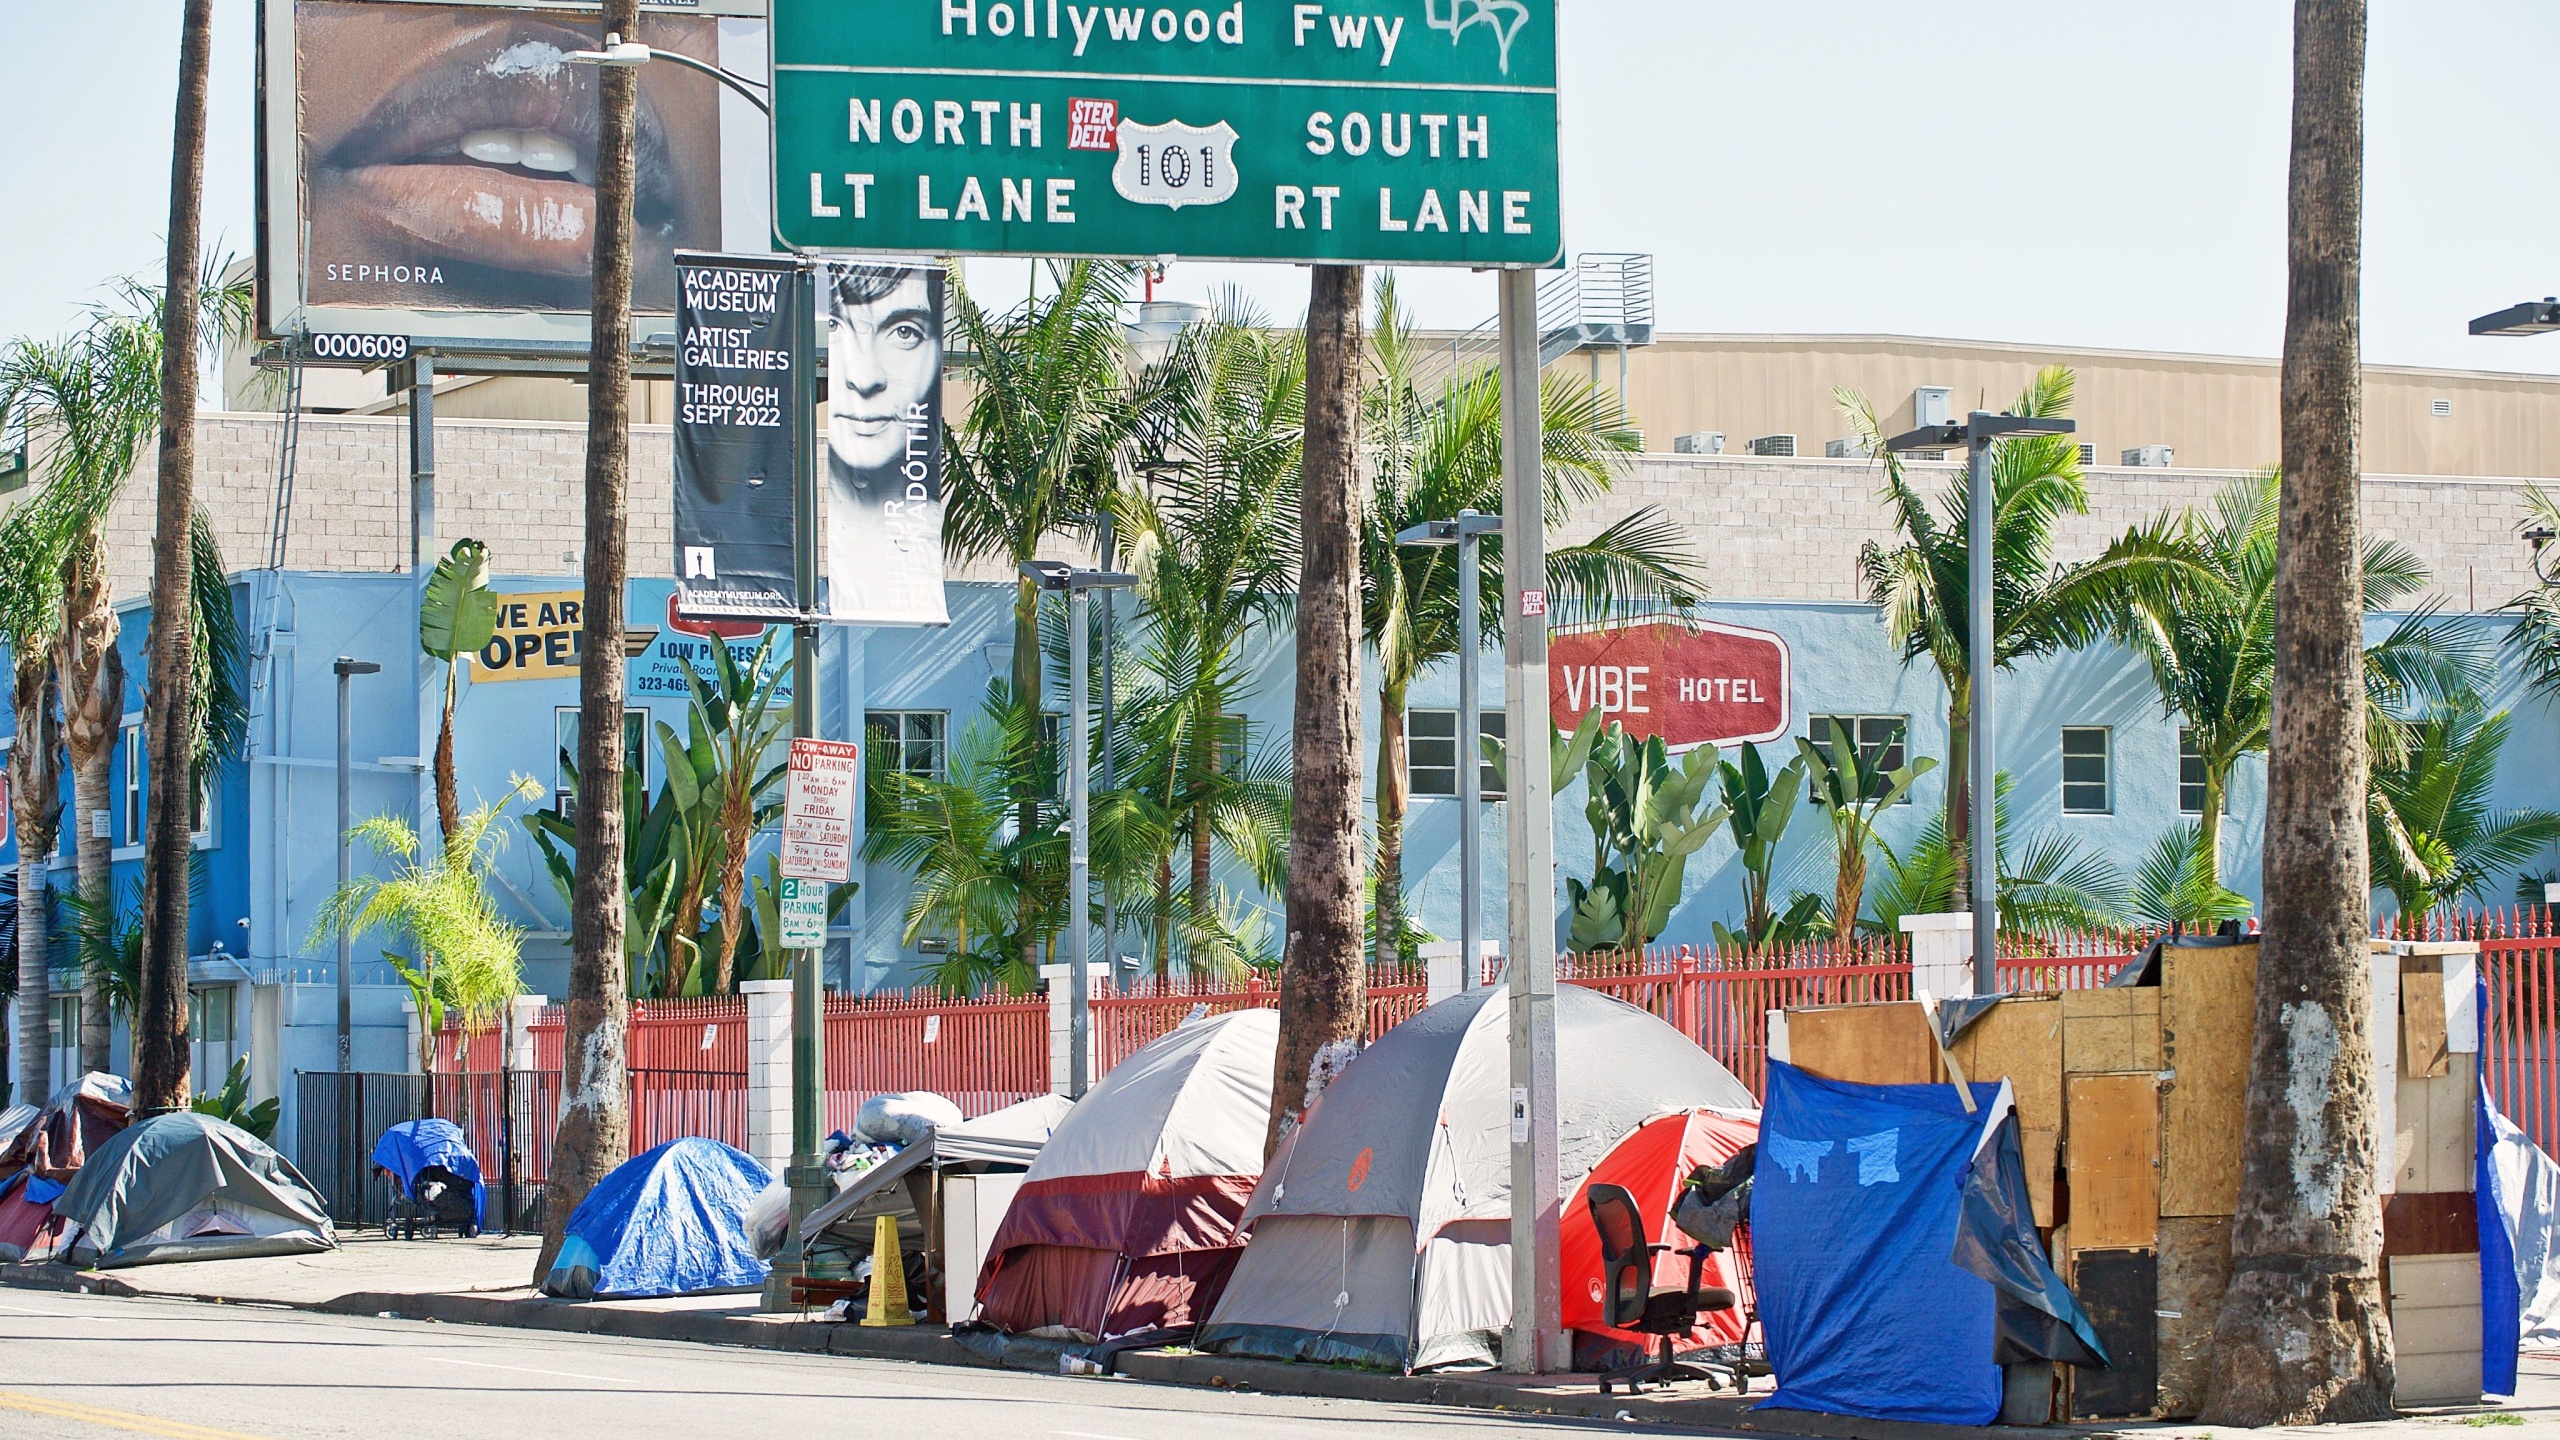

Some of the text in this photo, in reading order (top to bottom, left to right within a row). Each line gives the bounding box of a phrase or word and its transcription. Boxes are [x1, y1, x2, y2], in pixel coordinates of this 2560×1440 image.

[941, 0, 1244, 57] Hollywood
[1294, 4, 1404, 67] Fwy
[849, 98, 1041, 148] NORTH
[1071, 99, 1115, 132] STER
[1306, 111, 1488, 159] SOUTH
[1137, 144, 1214, 188] 101
[810, 172, 1076, 223] LT LANE
[1275, 185, 1531, 234] RT LANE
[327, 263, 444, 284] SEPHORA
[685, 269, 781, 294] ACADEMY
[686, 289, 776, 314] MUSEUM
[314, 334, 407, 359] 000609
[684, 326, 751, 349] ARTIST
[684, 347, 790, 371] GALLERIES
[682, 383, 779, 407] THROUGH
[682, 404, 781, 427] SEPT 2022
[688, 589, 782, 601] ACADEMYMUSEUM.ORG
[1522, 591, 1543, 606] STER
[536, 601, 584, 628] AR
[660, 642, 694, 660] LOW
[1563, 665, 1765, 713] VIBE HOTEL
[794, 741, 854, 757] TOW-AWAY
[791, 752, 853, 773] NO PARKING
[803, 784, 839, 797] MONDAY
[813, 796, 829, 804] THRU
[804, 804, 835, 816] FRIDAY
[786, 828, 807, 841] FRIDAY
[819, 831, 849, 844] SATURDAY
[785, 855, 814, 867] SATURDAY
[824, 859, 846, 870] SUNDAY
[784, 881, 824, 897] 2 HOUR
[784, 901, 824, 915] PARKING
